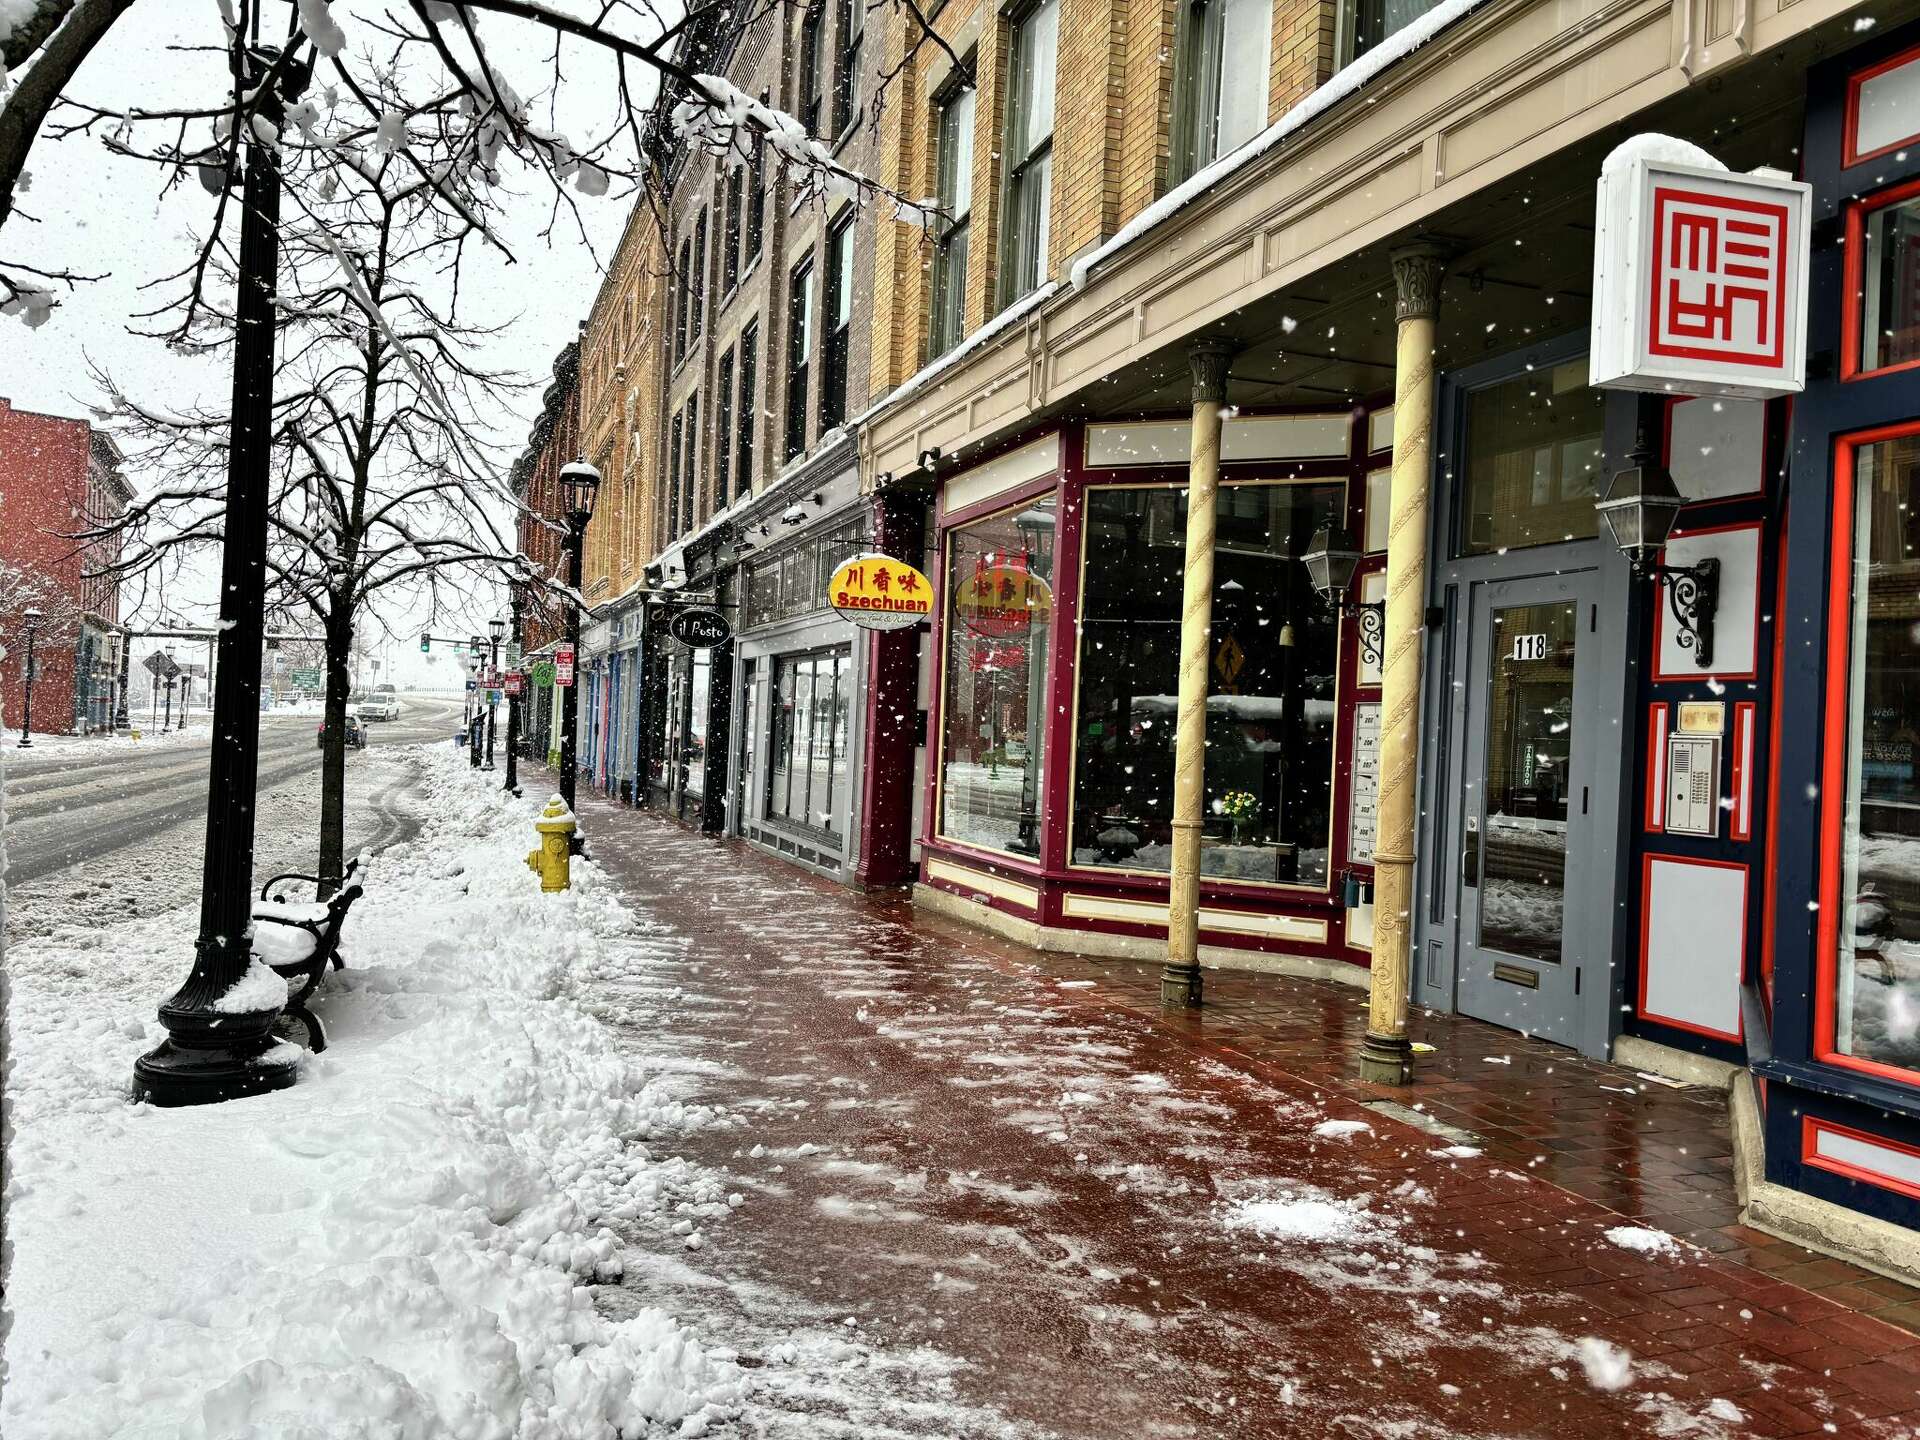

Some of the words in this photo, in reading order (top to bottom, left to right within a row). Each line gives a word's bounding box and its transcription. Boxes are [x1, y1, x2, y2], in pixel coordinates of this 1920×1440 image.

[846, 566, 920, 594] 川香味
[837, 592, 928, 611] Szechuan
[679, 620, 687, 636] il
[692, 621, 723, 638] Posto
[1516, 635, 1545, 659] 118
[1524, 745, 1533, 786] TATTOO
